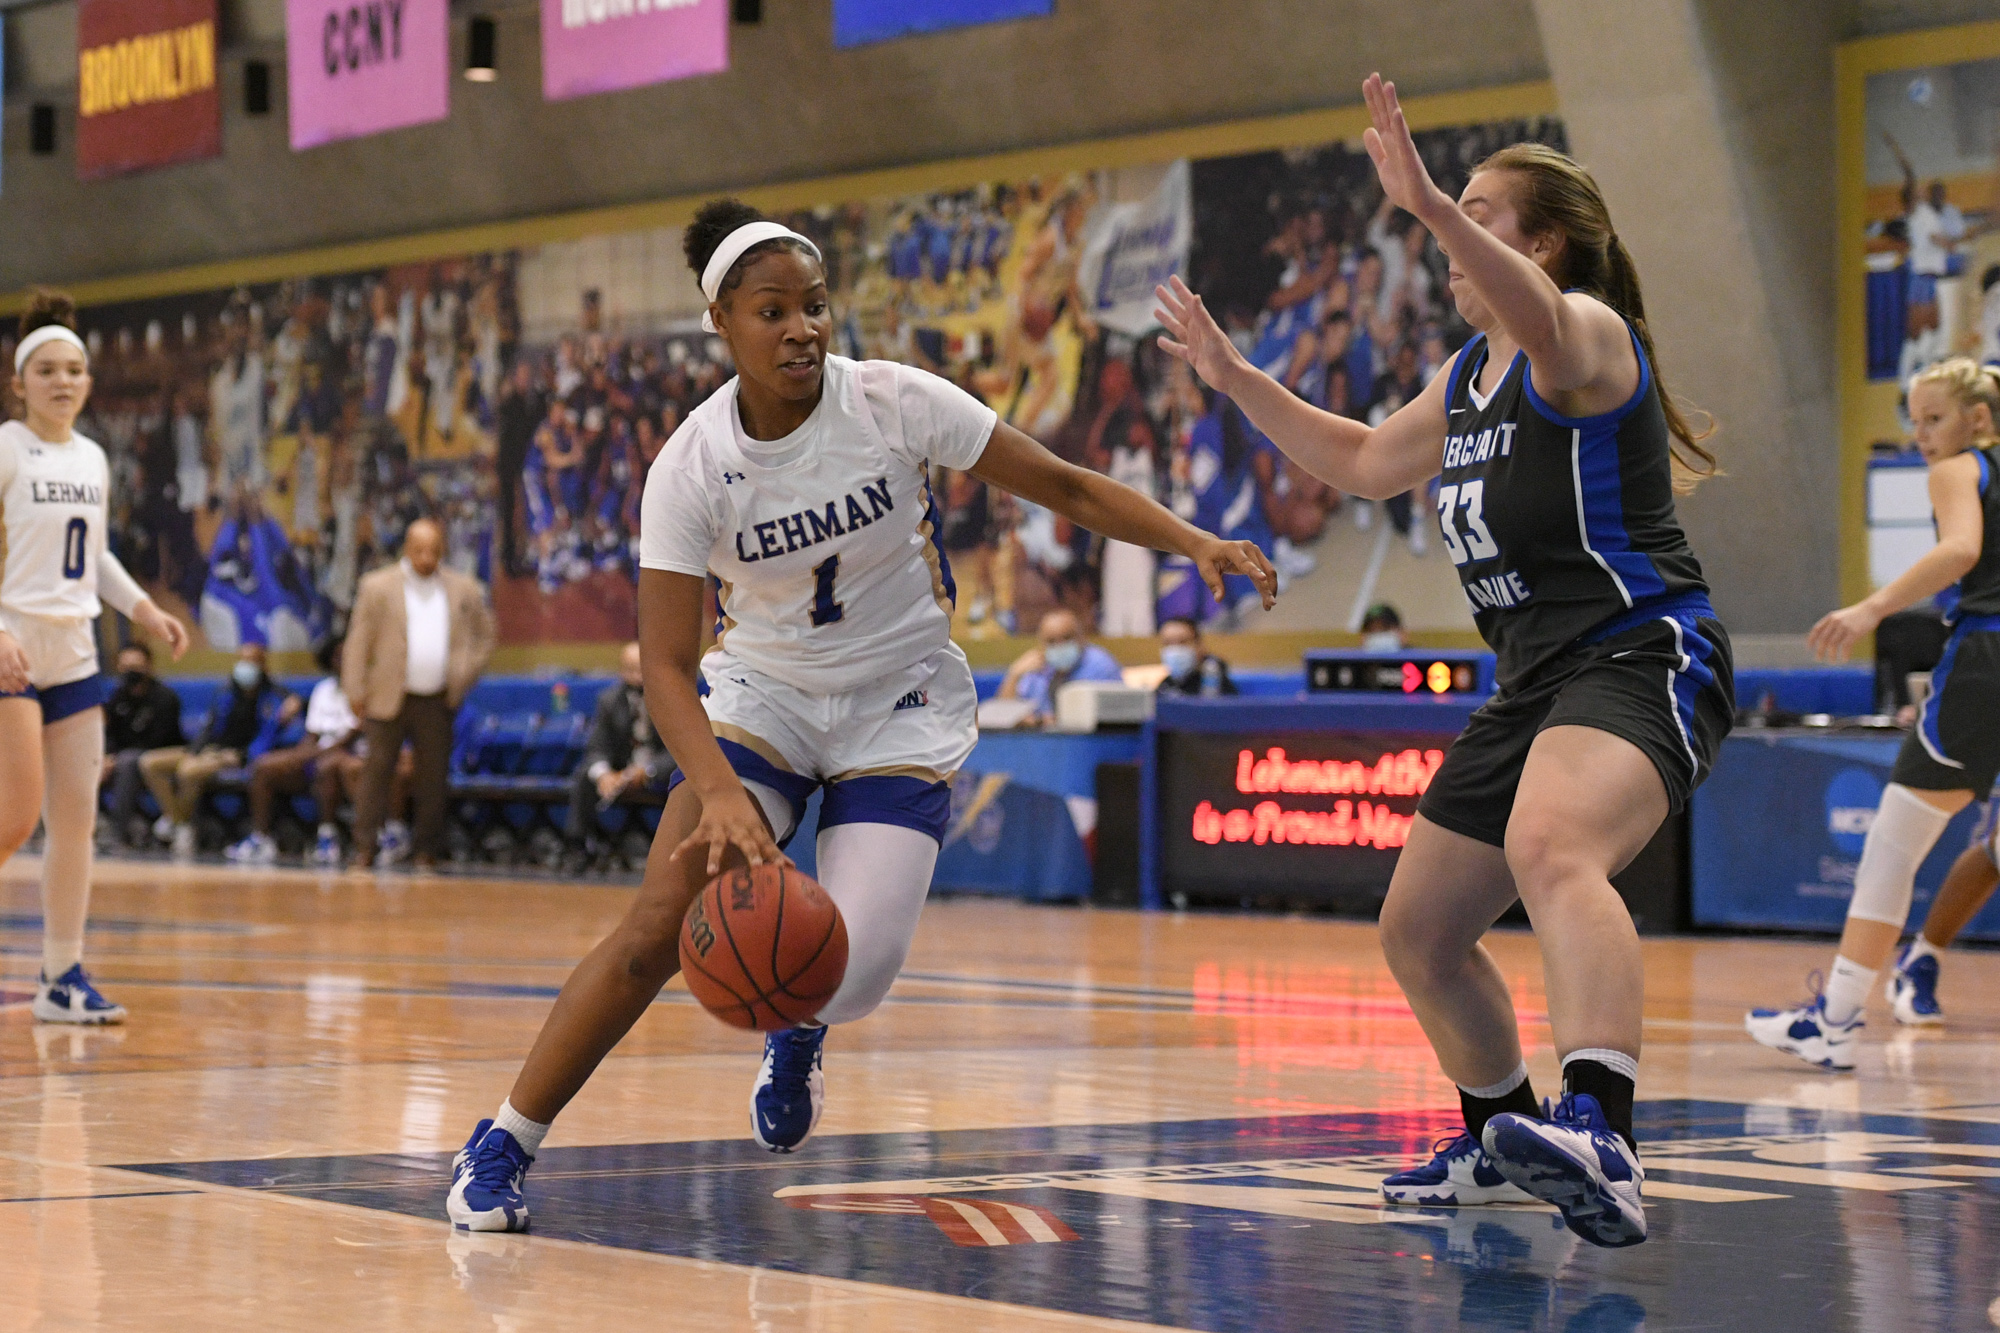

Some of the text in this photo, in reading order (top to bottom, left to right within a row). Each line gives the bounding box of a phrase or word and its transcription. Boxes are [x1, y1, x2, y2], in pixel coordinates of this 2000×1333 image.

[79, 18, 216, 117] BROOKLYN
[322, 0, 405, 76] CCNY
[64, 516, 88, 580] 0
[736, 477, 895, 563] LEHMAN
[1438, 478, 1500, 567] 33
[807, 553, 845, 628] 1
[1236, 747, 1366, 795] Lehman
